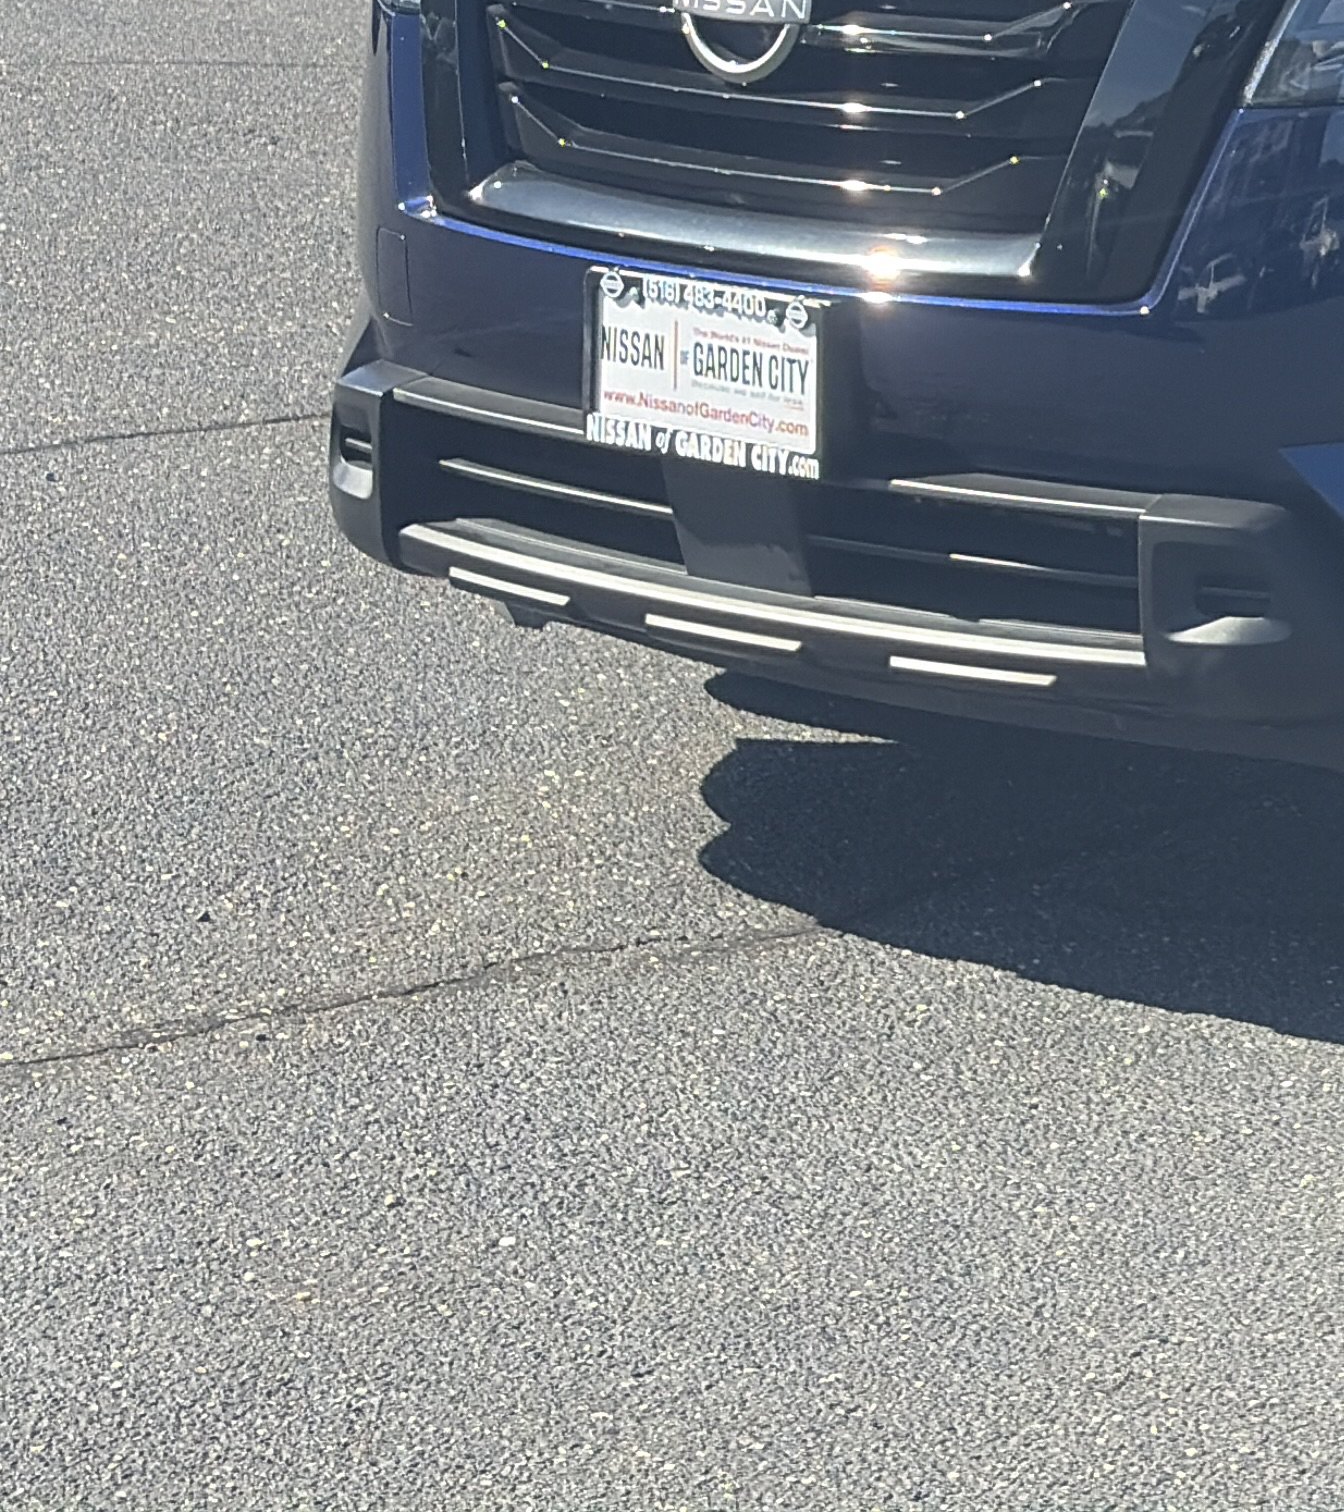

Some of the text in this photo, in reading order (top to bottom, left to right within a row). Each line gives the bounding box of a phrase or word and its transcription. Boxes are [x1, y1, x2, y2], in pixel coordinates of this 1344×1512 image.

[642, 275, 766, 318] (516) 483-4400
[601, 325, 665, 370] NISSAN
[693, 341, 763, 389] GARDEN
[768, 354, 810, 395] CITY
[603, 388, 809, 437] www.NissanofGardenCity.com
[586, 412, 820, 480] NISSAN of GARDEN CITY.com
